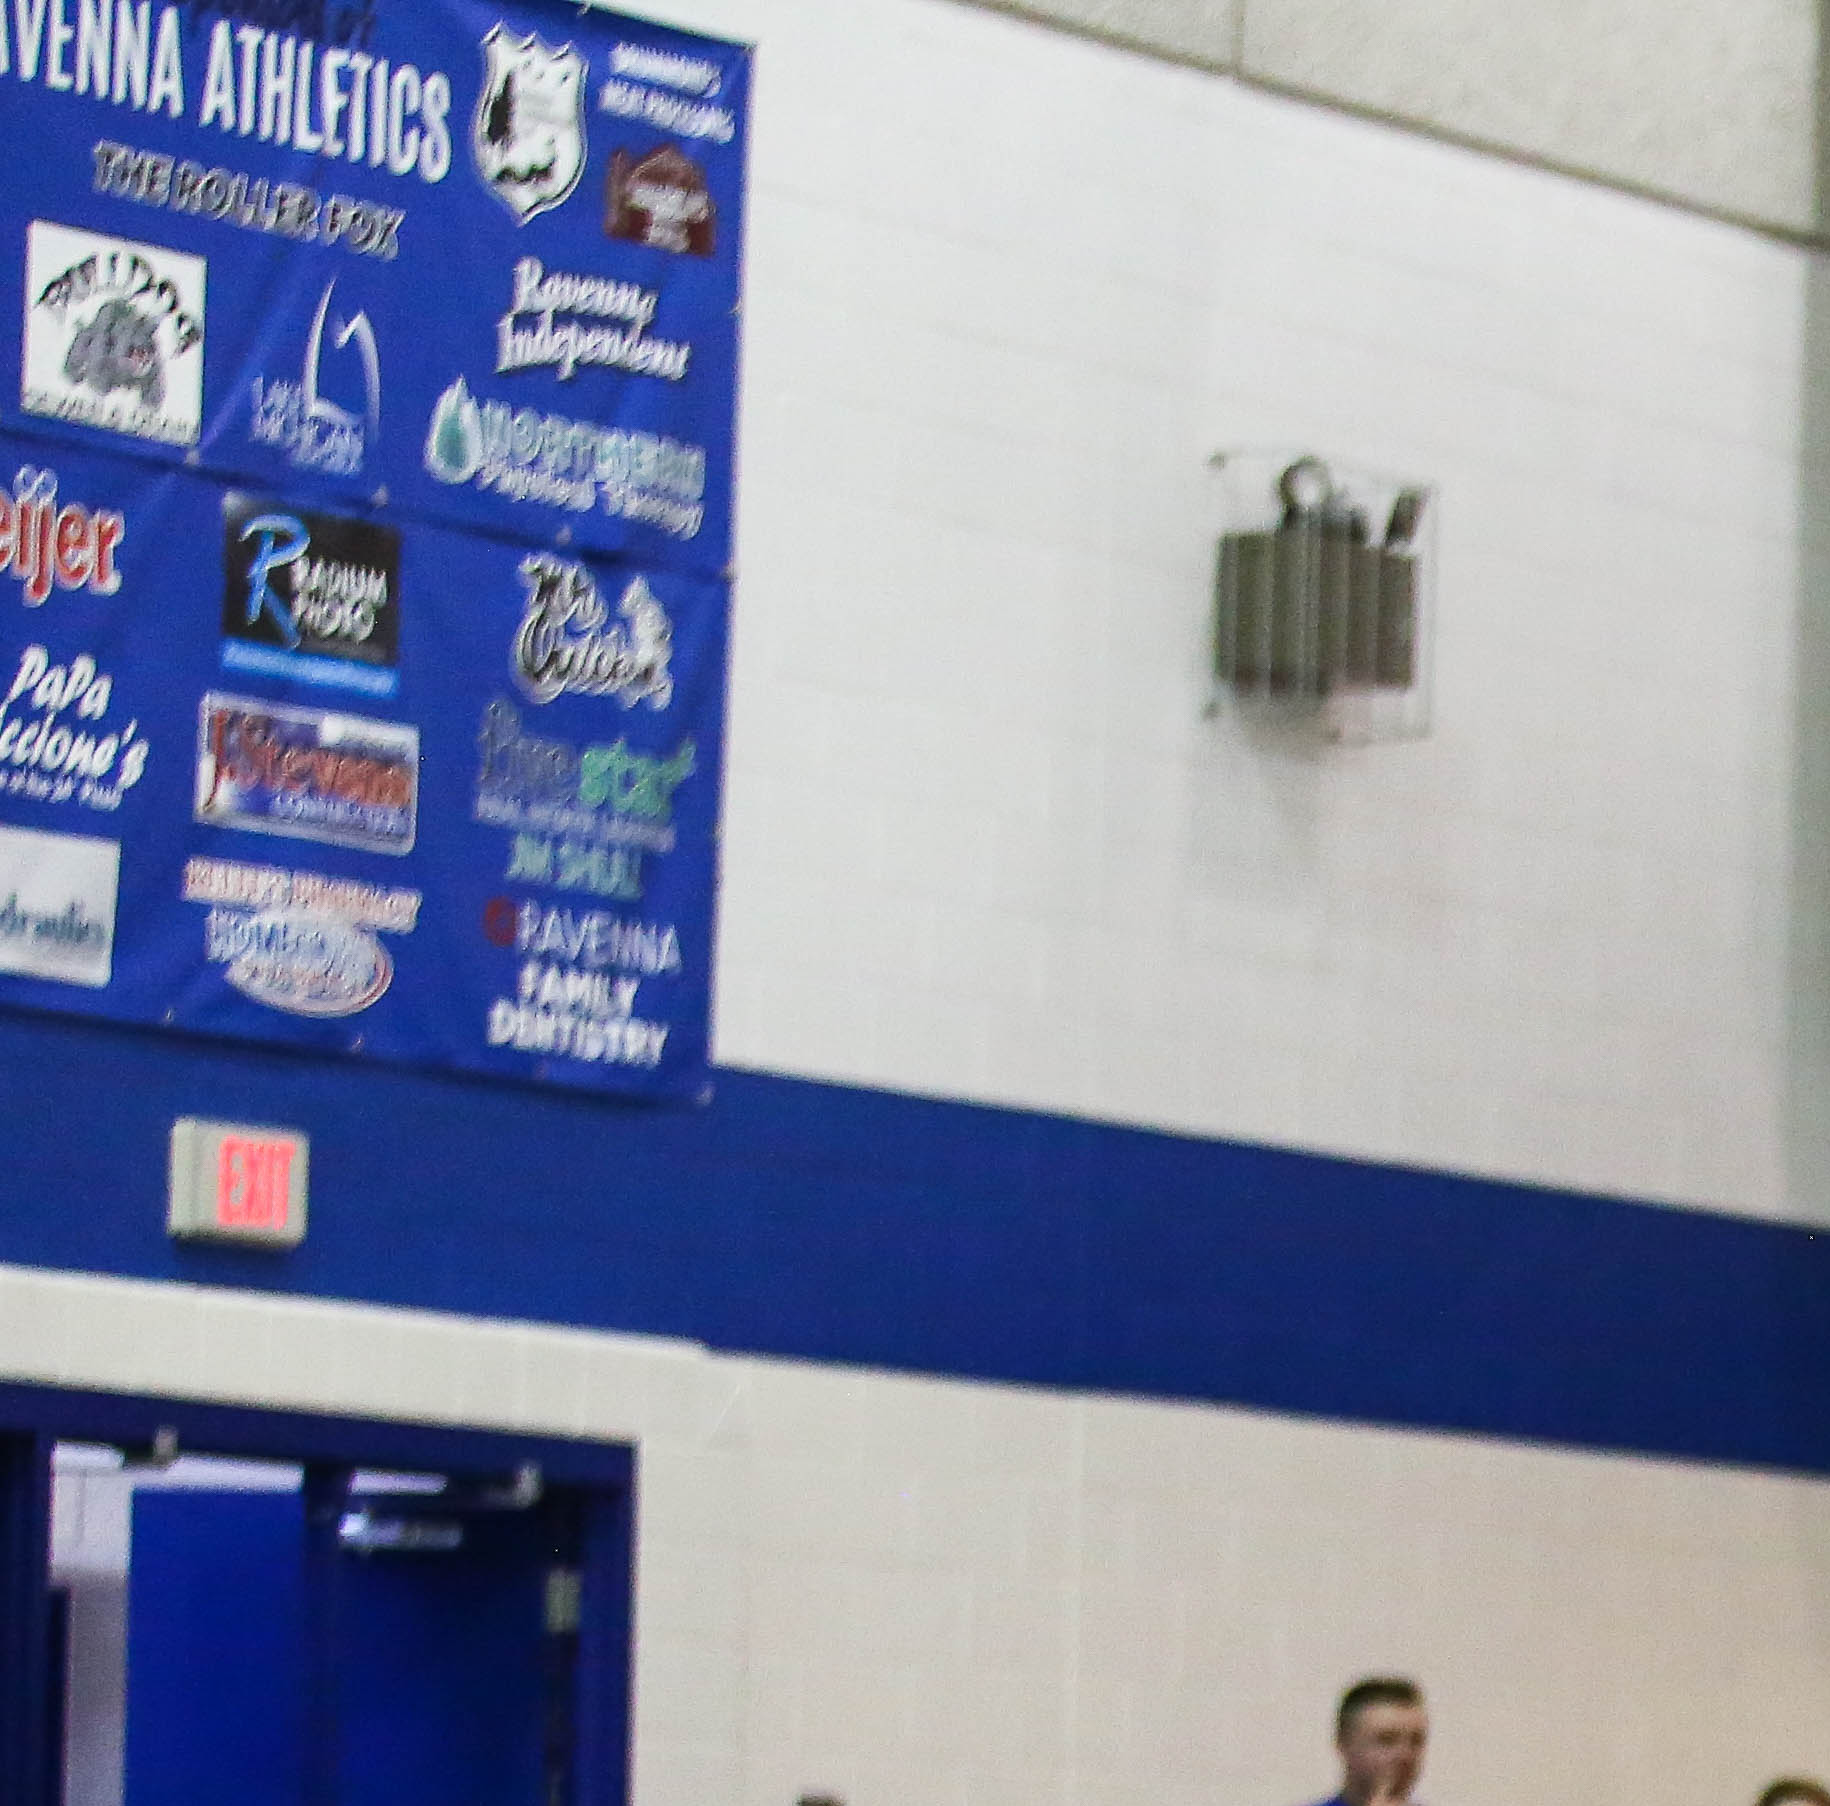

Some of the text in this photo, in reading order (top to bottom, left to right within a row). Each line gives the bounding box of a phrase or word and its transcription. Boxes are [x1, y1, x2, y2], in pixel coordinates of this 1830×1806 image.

[200, 18, 453, 184] ATHLETICS
[93, 140, 174, 207] THE
[512, 256, 658, 327] Ravenna
[494, 308, 691, 382] Independent
[217, 1135, 296, 1231] EXIT
